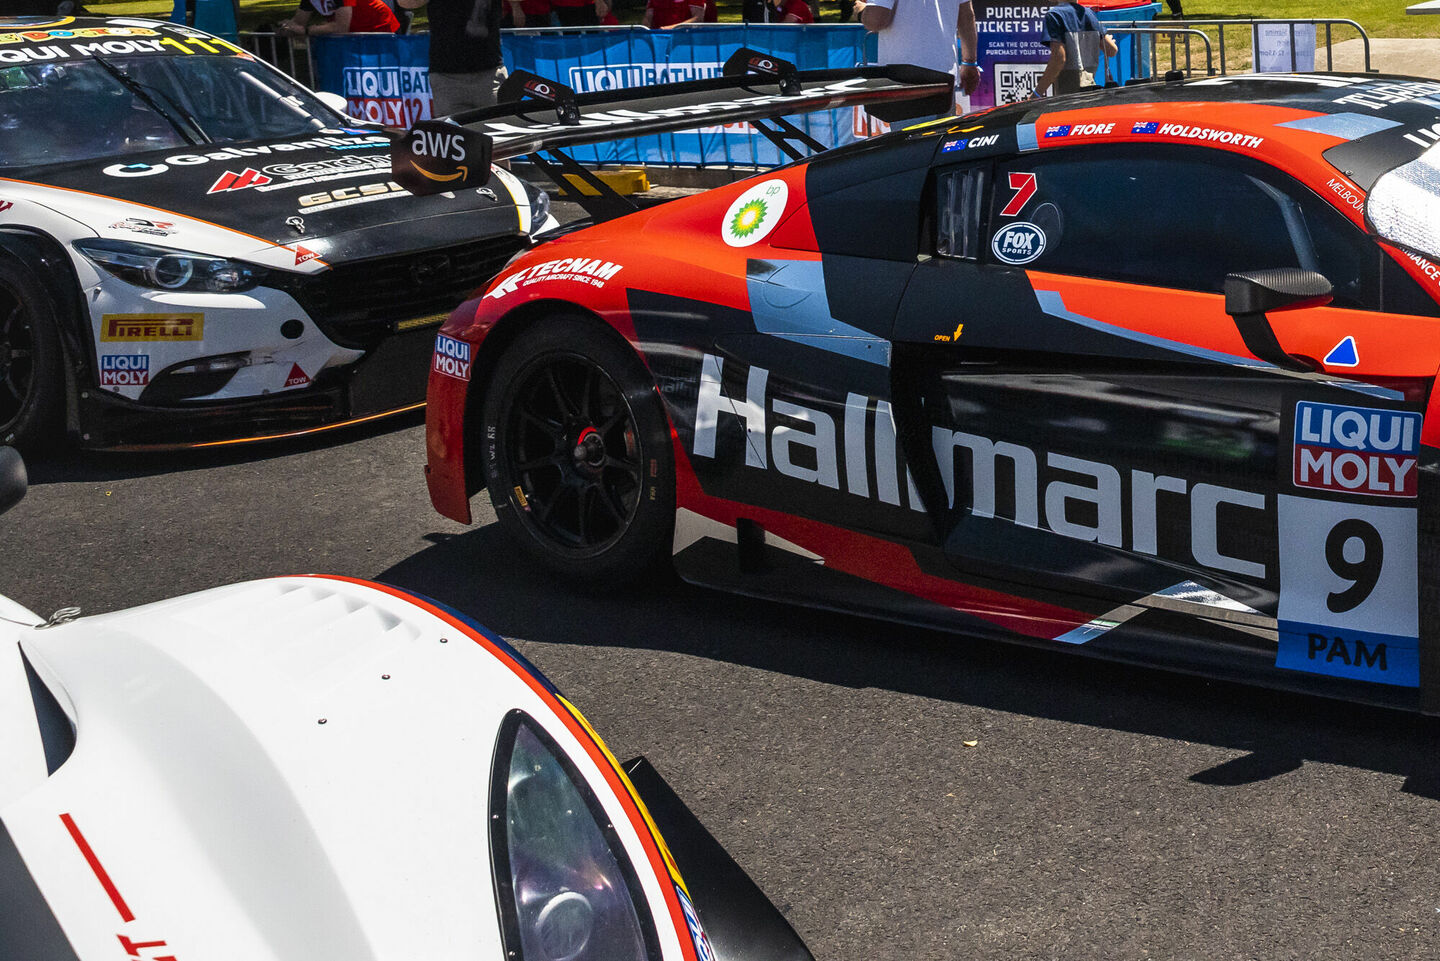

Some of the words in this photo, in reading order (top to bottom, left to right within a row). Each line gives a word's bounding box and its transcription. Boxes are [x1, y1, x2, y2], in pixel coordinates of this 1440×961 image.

[986, 6, 1053, 19] PURCHAS
[975, 21, 1030, 32] TICKETS
[1035, 22, 1043, 32] H
[72, 39, 166, 56] MOLY
[161, 37, 244, 55] 111
[346, 70, 399, 97] LIQUI
[401, 70, 430, 94] BAT
[574, 69, 644, 93] LIQUI
[348, 99, 403, 128] MOLY
[1070, 122, 1116, 137] FIORE
[1158, 123, 1265, 149] HOLDSWORTH
[411, 129, 466, 161] aws
[967, 134, 1000, 149] CINI
[765, 184, 781, 196] bp
[1000, 172, 1038, 217] 7
[1003, 231, 1035, 250] FOX
[297, 252, 315, 264] TOW
[1001, 247, 1032, 256] SPORTS
[527, 257, 624, 281] TECNAM
[107, 318, 194, 337] PIRELLI
[934, 334, 951, 342] OPEN
[436, 336, 469, 361] LIQUI
[103, 356, 147, 370] LIQUI
[435, 357, 470, 378] MOLY
[102, 370, 148, 385] MOLY
[288, 376, 306, 384] TOW
[1301, 406, 1415, 451] LIQUI
[692, 353, 1267, 579] Hallmarc
[1300, 448, 1417, 492] MOLY
[1325, 518, 1384, 614] 9
[1307, 632, 1388, 671] PAM
